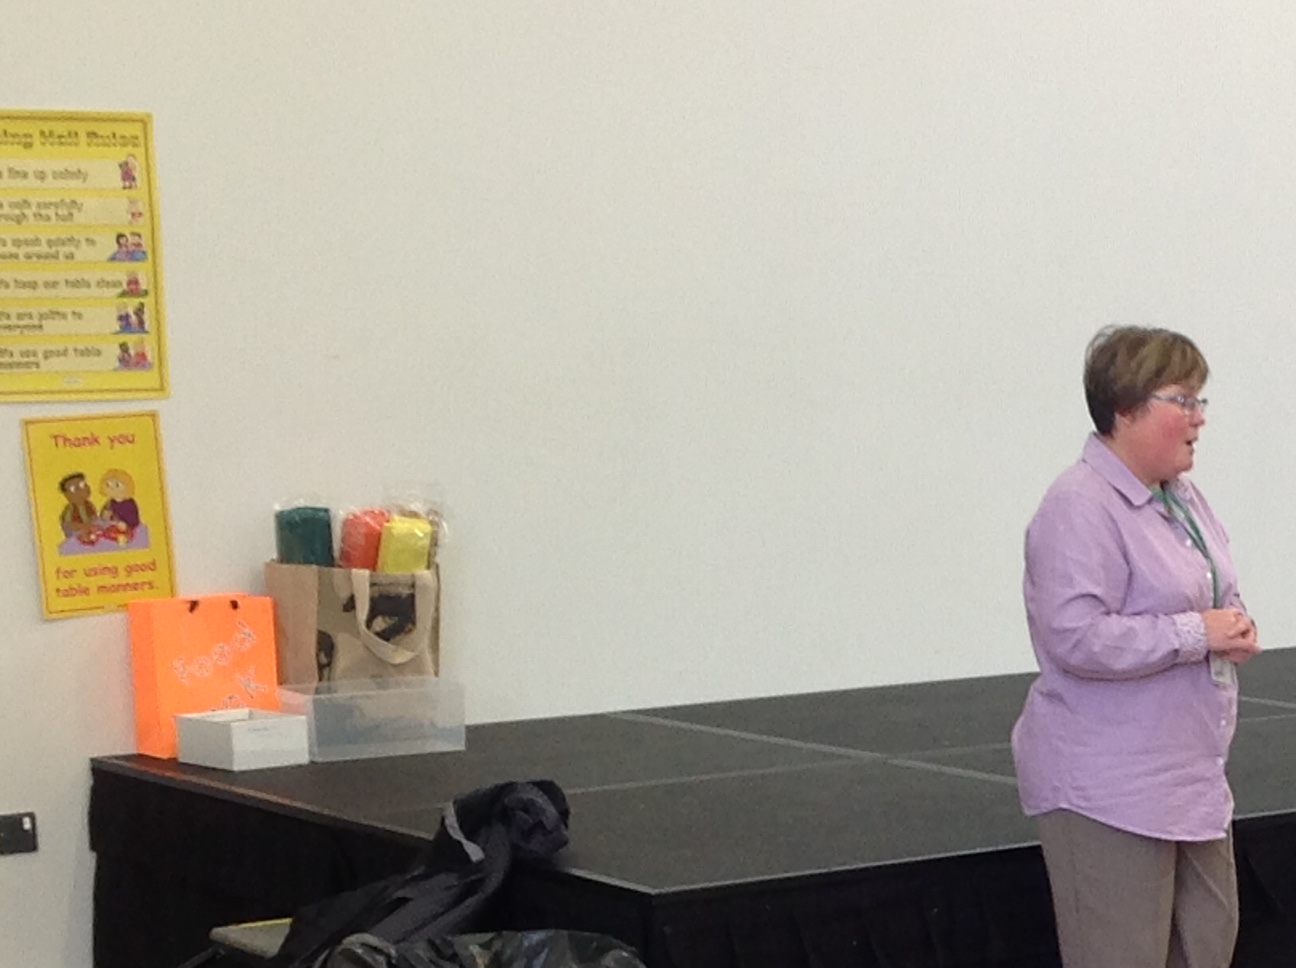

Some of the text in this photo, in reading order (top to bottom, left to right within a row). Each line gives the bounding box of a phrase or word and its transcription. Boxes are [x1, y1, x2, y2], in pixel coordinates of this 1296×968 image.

[50, 431, 136, 451] Thank you
[55, 557, 157, 580] for using good
[56, 582, 90, 598] table
